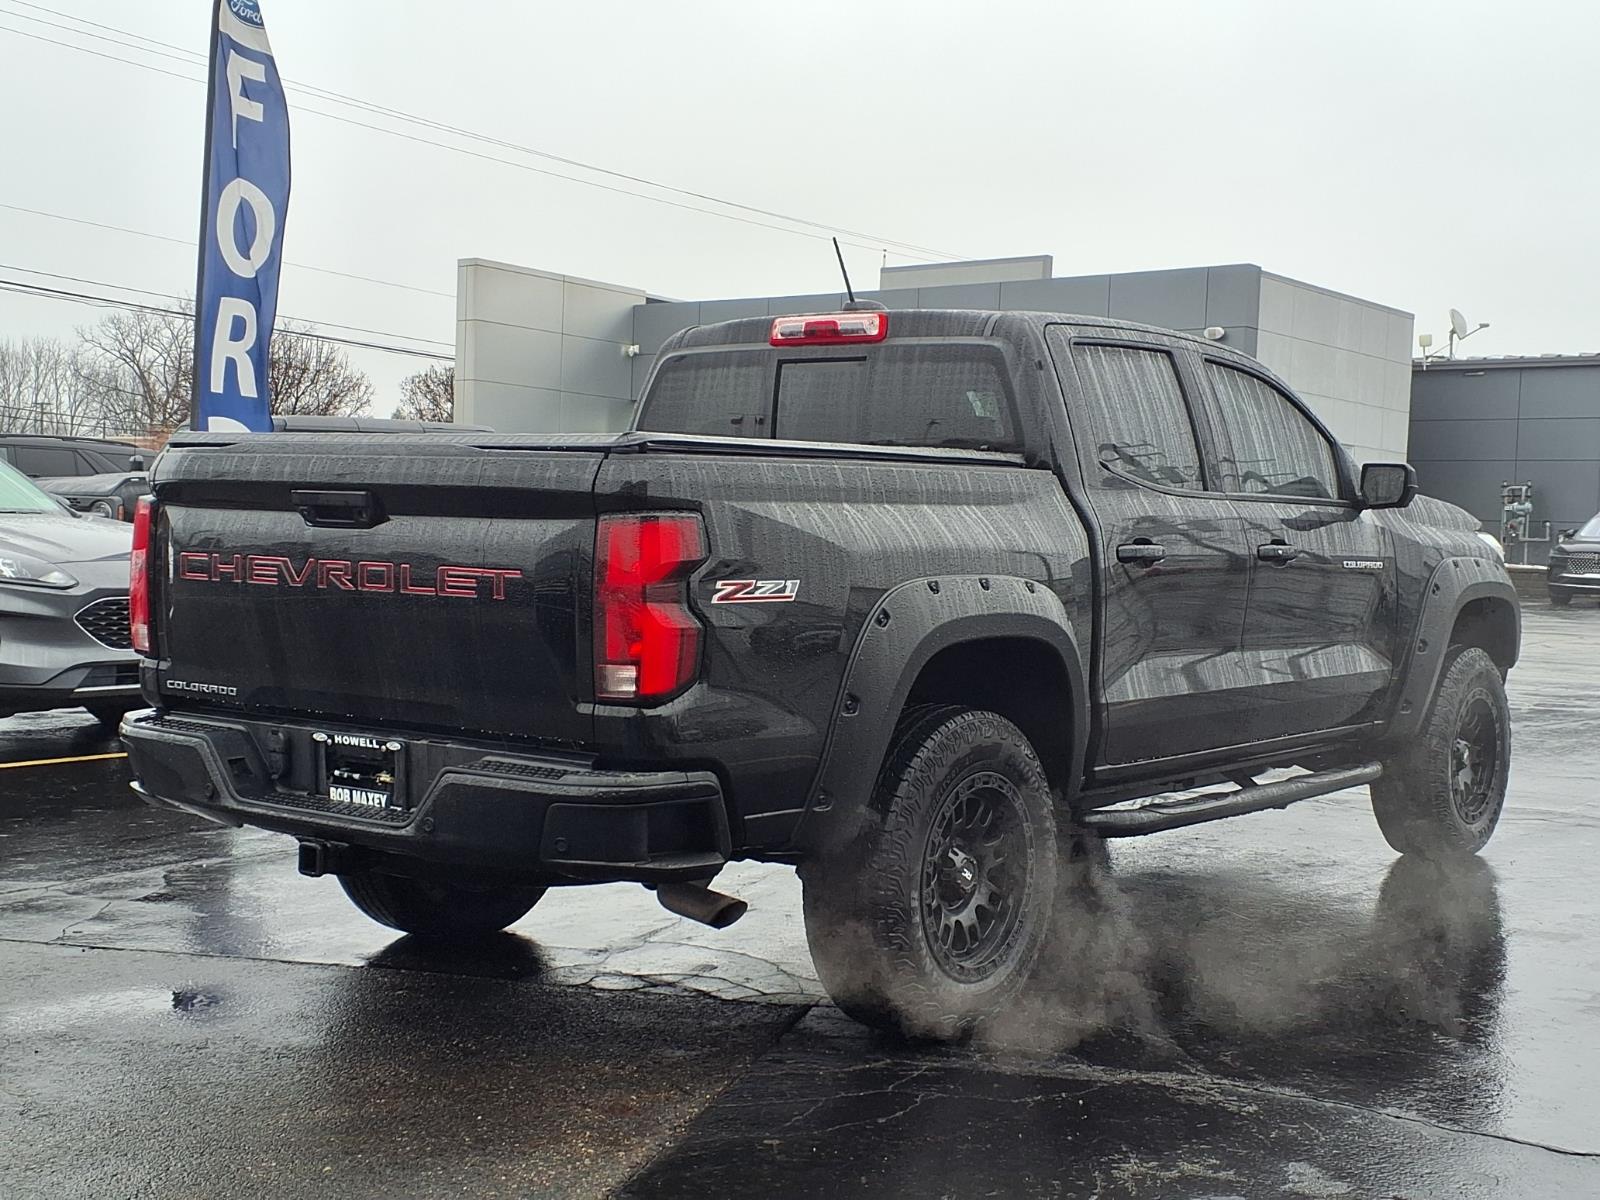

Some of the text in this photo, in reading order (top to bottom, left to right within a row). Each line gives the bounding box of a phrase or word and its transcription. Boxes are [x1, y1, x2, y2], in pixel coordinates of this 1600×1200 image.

[208, 49, 275, 431] FOR
[179, 551, 523, 600] CHEVROLET
[711, 579, 800, 604] Z71
[166, 680, 237, 696] COLORADO
[334, 734, 380, 749] HOWELL
[329, 786, 388, 808] BOB MAXEY
